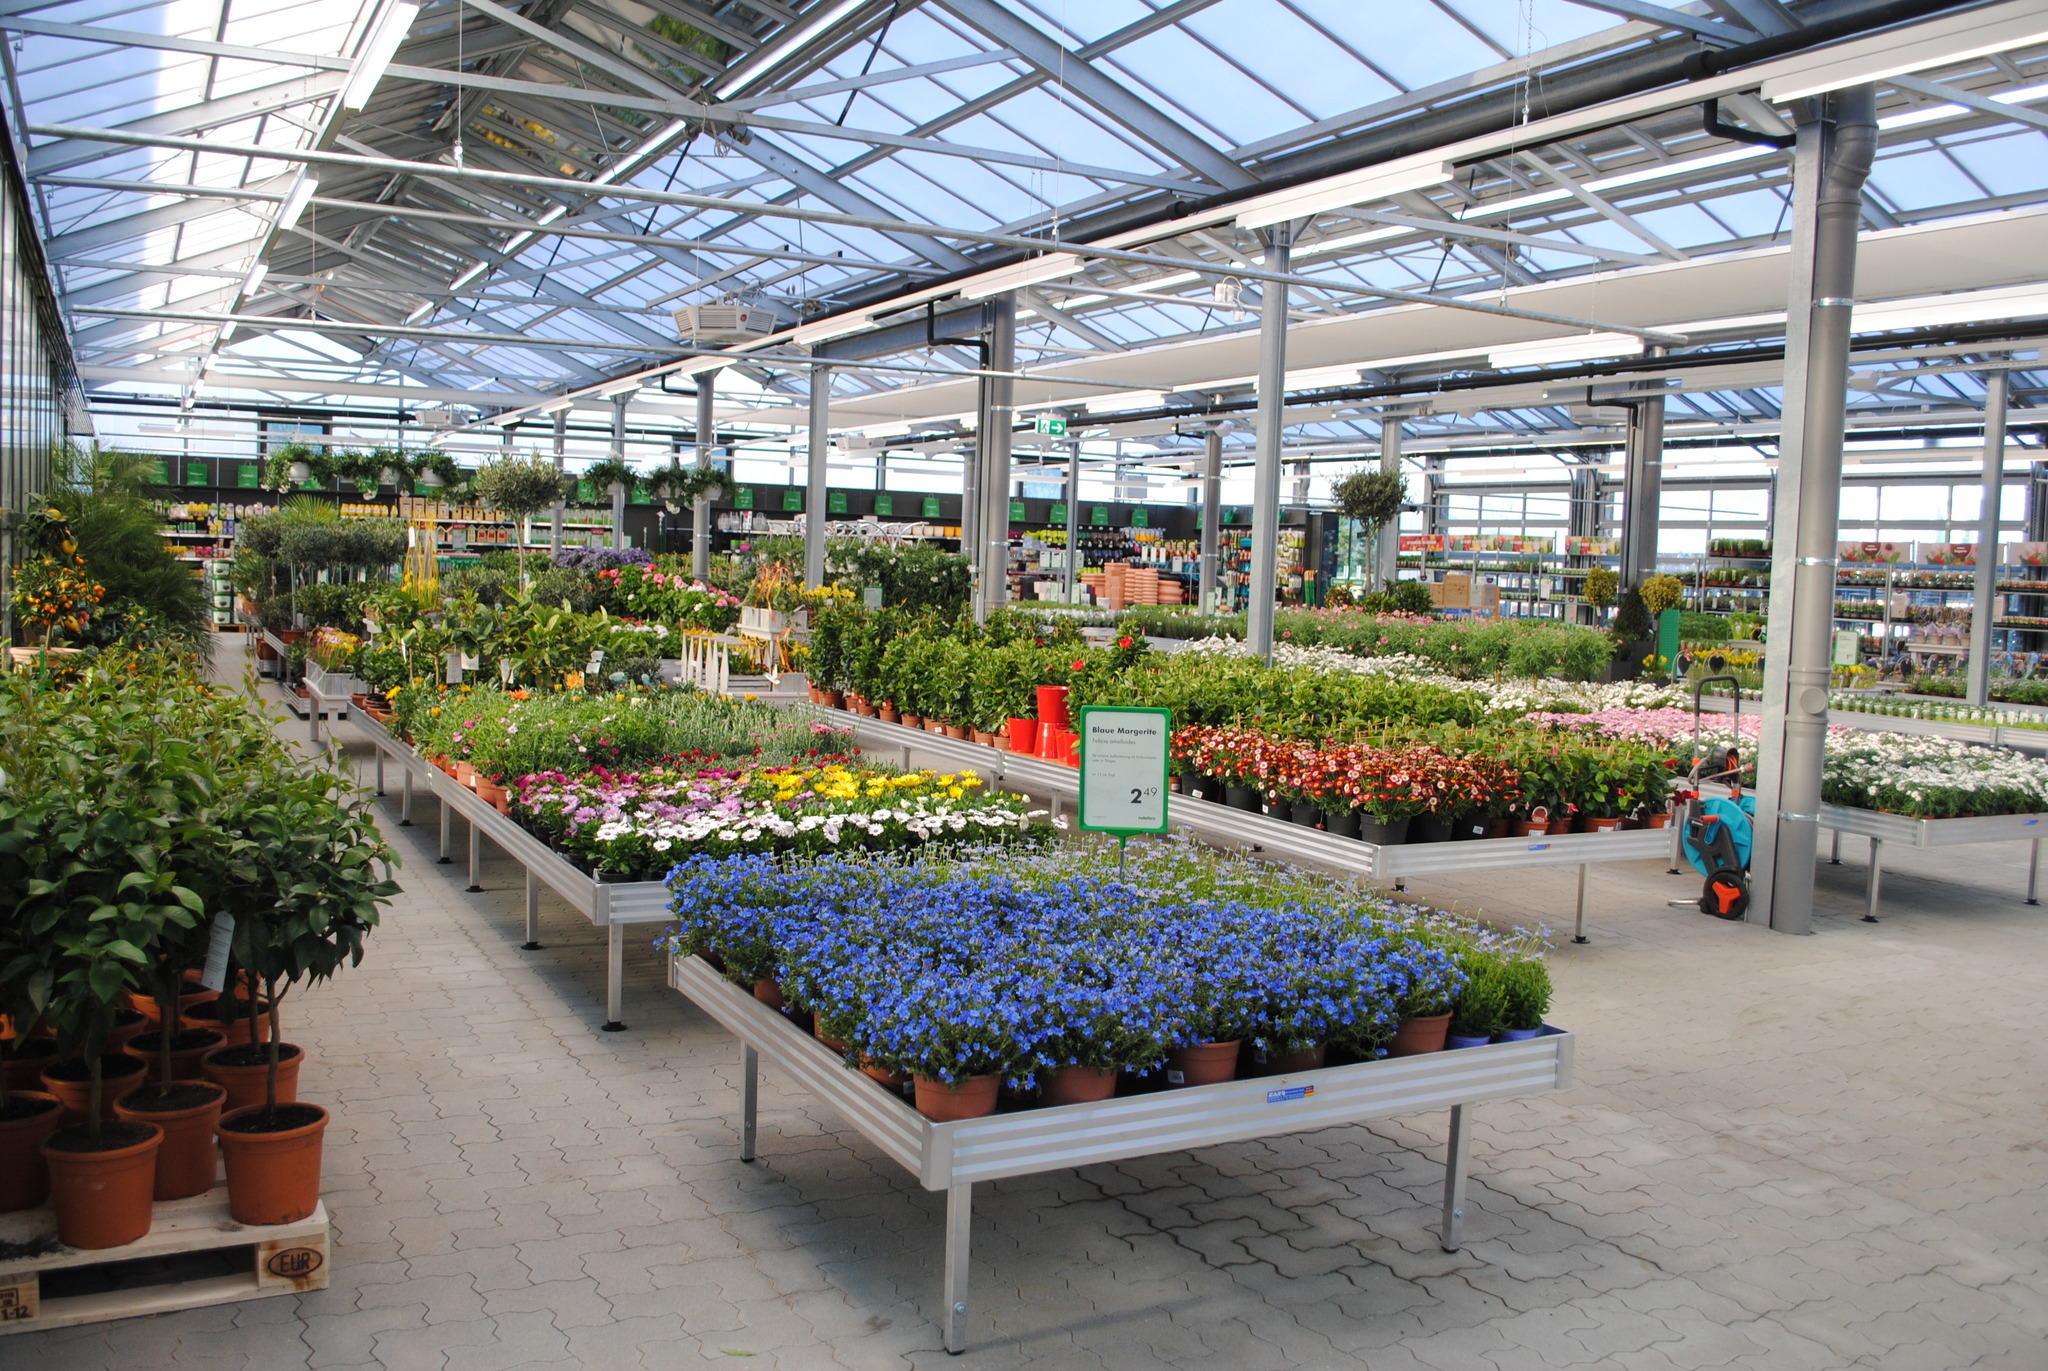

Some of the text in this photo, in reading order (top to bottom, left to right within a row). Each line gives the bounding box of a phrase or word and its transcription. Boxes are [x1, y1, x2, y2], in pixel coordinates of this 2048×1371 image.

[1092, 726, 1157, 737] Blaue Margerite
[280, 1252, 310, 1272] EUR
